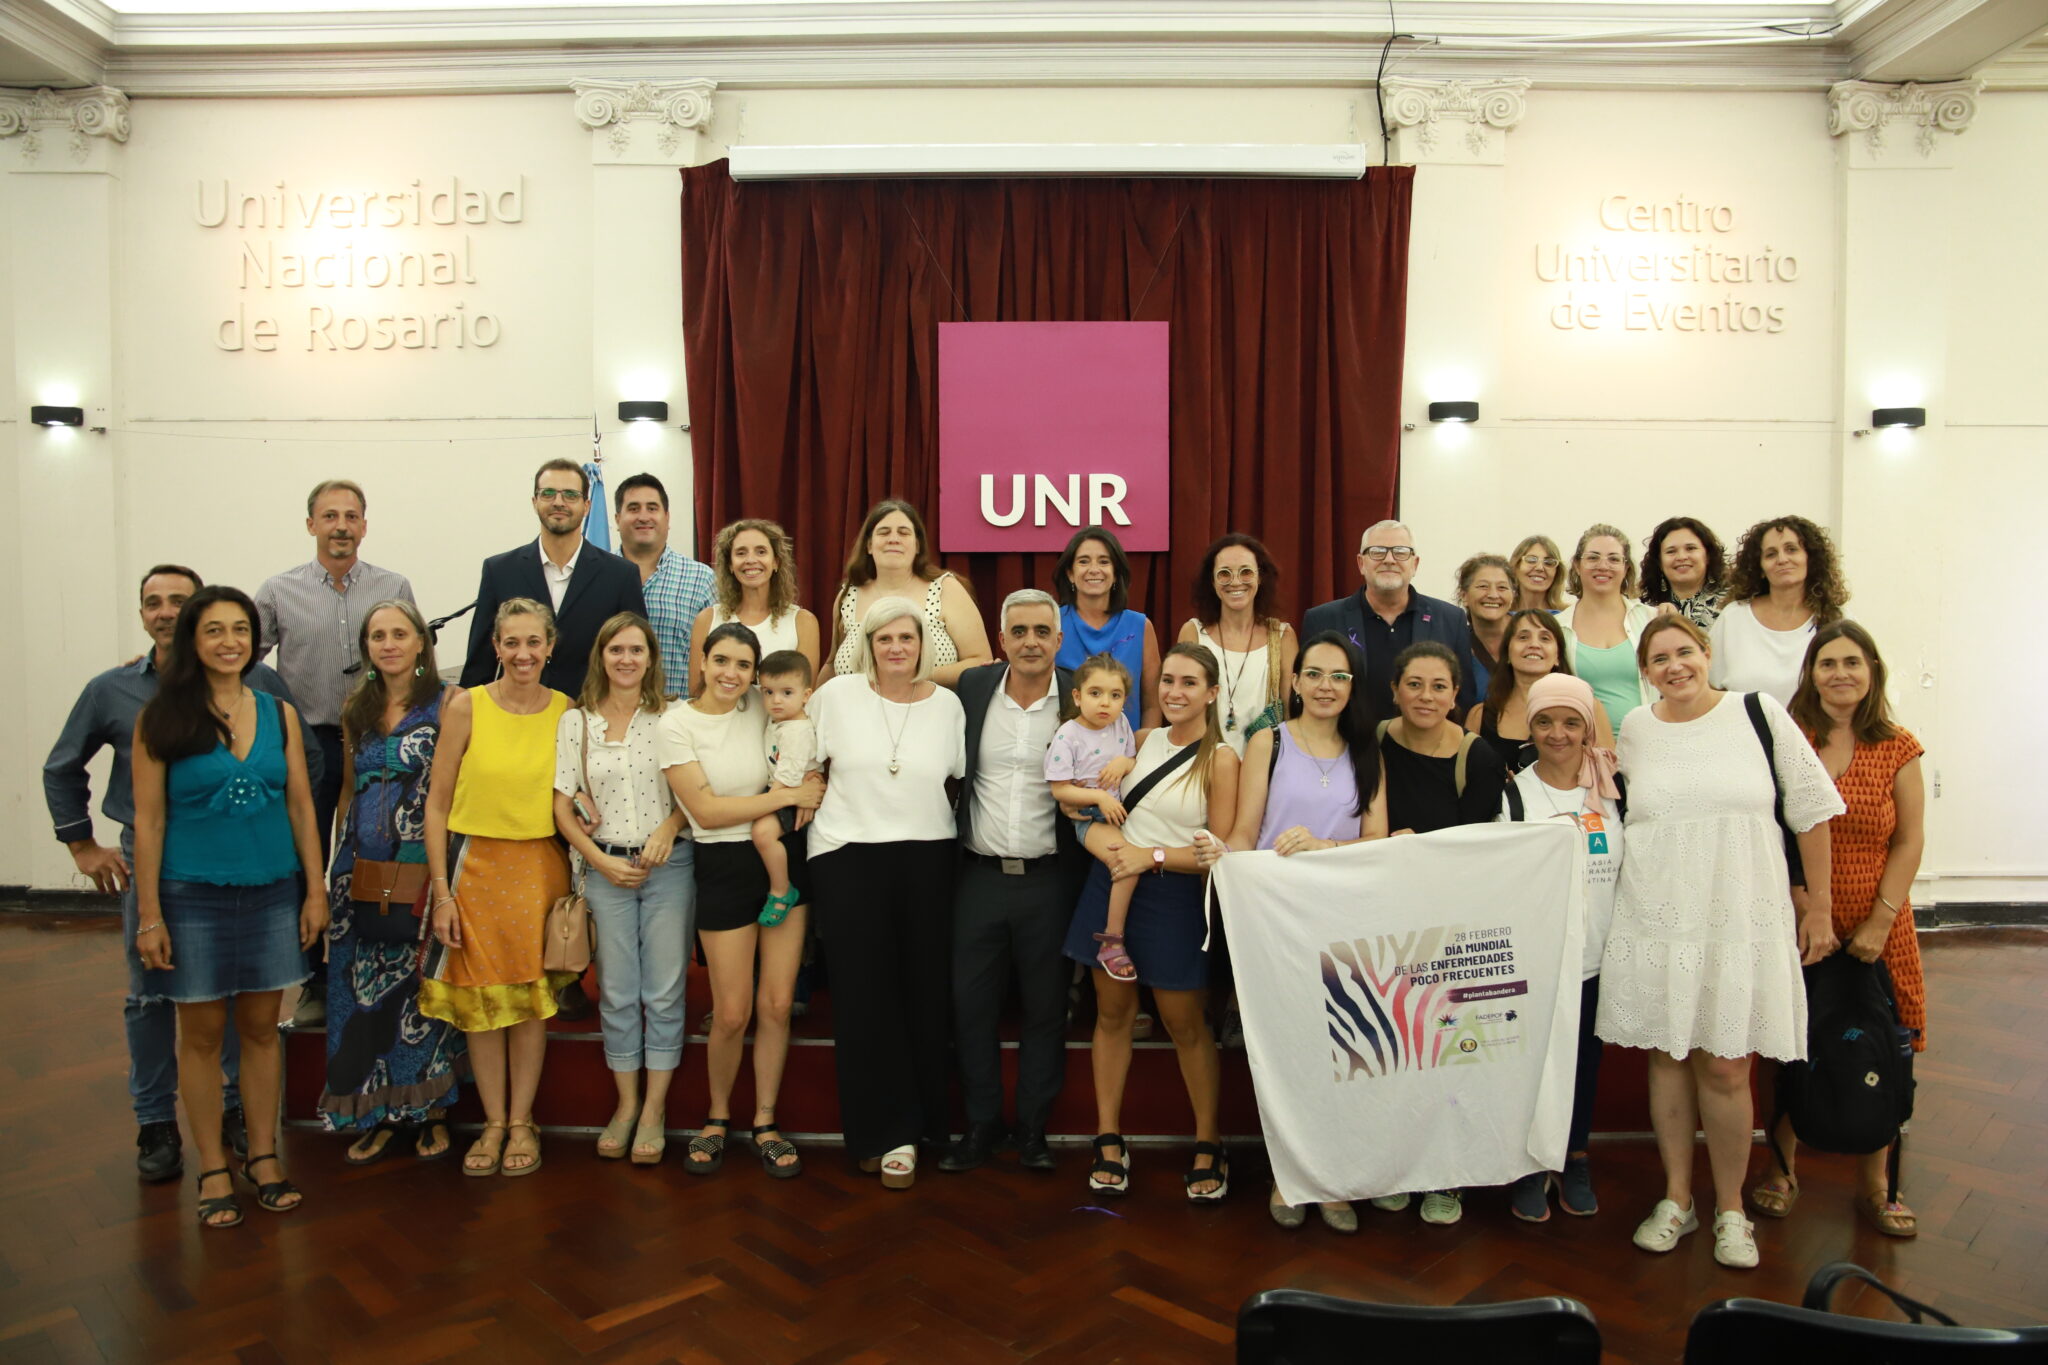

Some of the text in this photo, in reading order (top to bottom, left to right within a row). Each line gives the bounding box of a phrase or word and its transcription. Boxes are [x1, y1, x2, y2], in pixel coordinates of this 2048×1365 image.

[193, 174, 525, 229] Universidad
[1599, 193, 1734, 234] Centro
[239, 235, 477, 289] Nacional
[1535, 244, 1799, 283] Universitario
[214, 300, 501, 352] de Rosario
[1550, 290, 1785, 334] de Eventos
[980, 473, 1132, 527] UNR
[1594, 837, 1603, 847] A
[1445, 939, 1513, 956] DÍA MUNDIAL
[1454, 926, 1512, 942] 28 FEBRERO
[1394, 951, 1514, 976] DE LAS ENFERMEDADES
[1410, 964, 1515, 987] POCO FRECUENTES
[1463, 987, 1516, 999] #plantabandera
